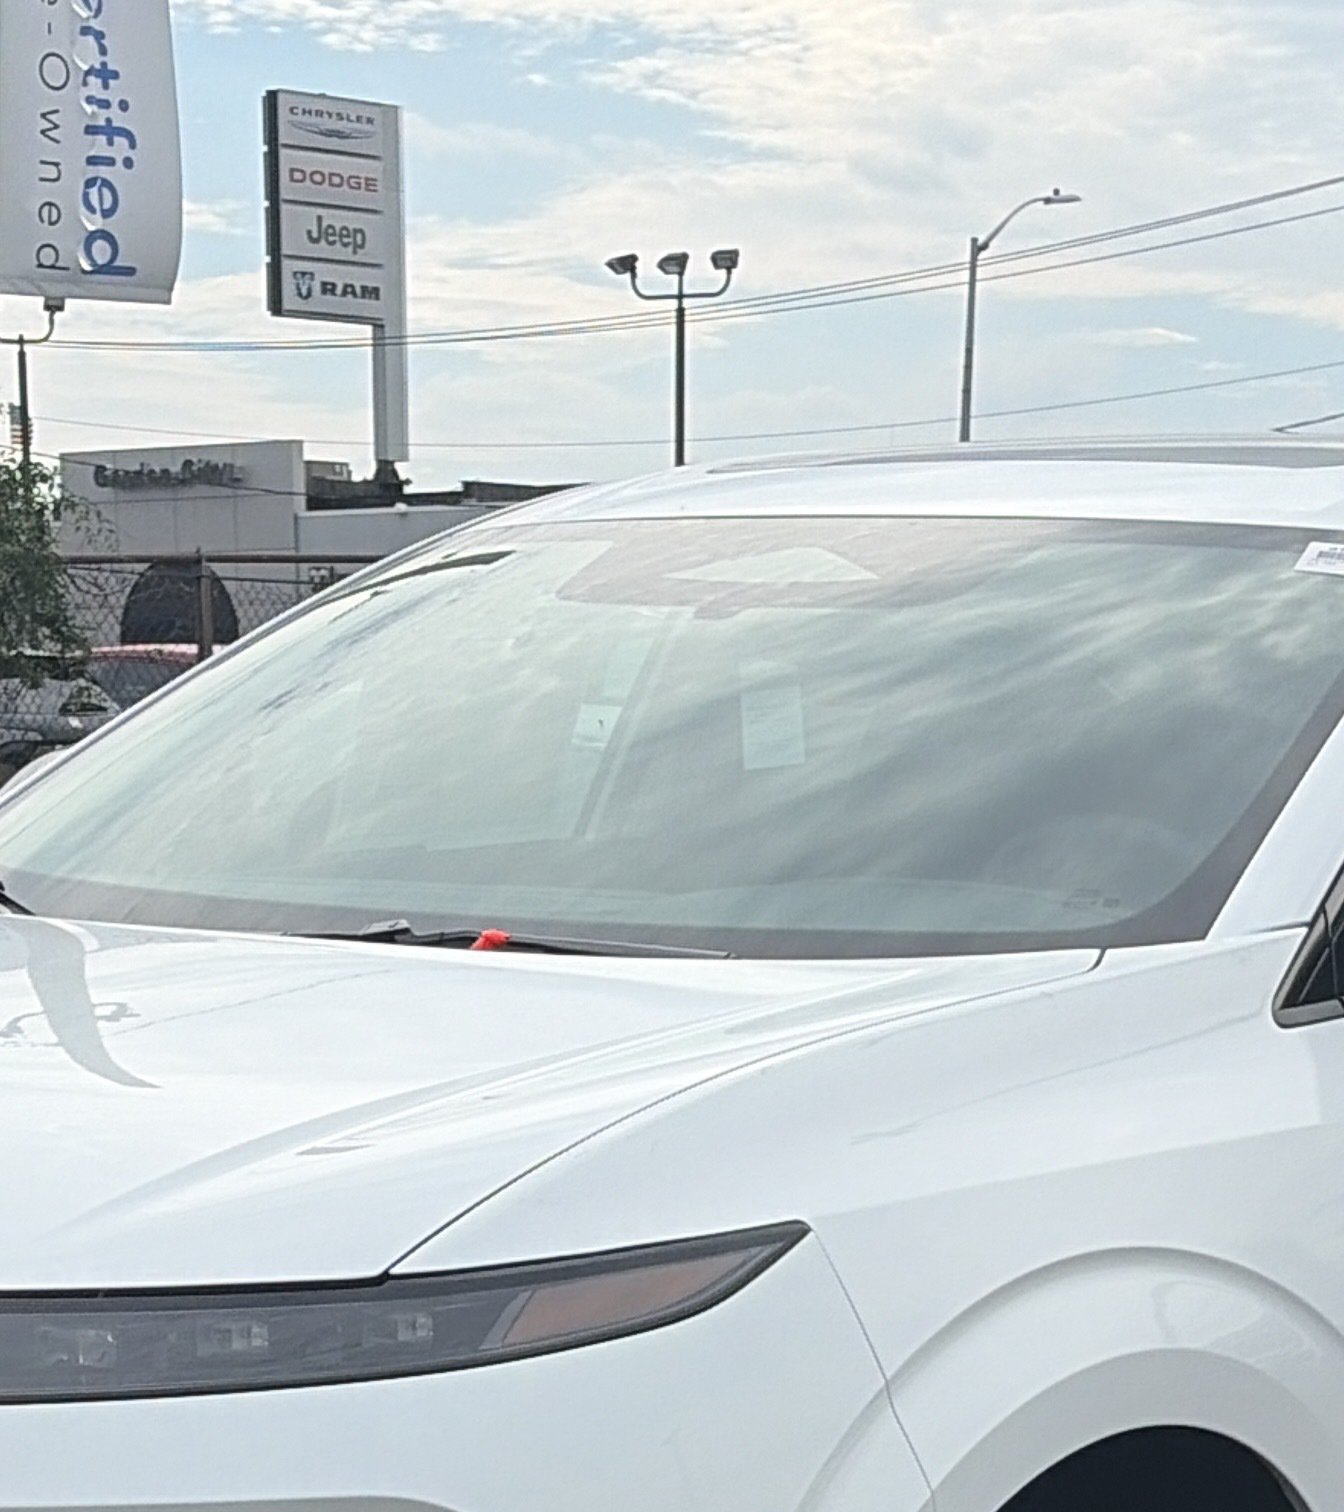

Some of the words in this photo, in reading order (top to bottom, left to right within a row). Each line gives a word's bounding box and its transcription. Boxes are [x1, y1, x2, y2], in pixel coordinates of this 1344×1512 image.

[288, 105, 376, 126] CHRYSLER
[35, 0, 71, 272] -Owned
[288, 166, 379, 193] DODGE
[307, 214, 367, 255] Jeep
[320, 280, 381, 301] RAM
